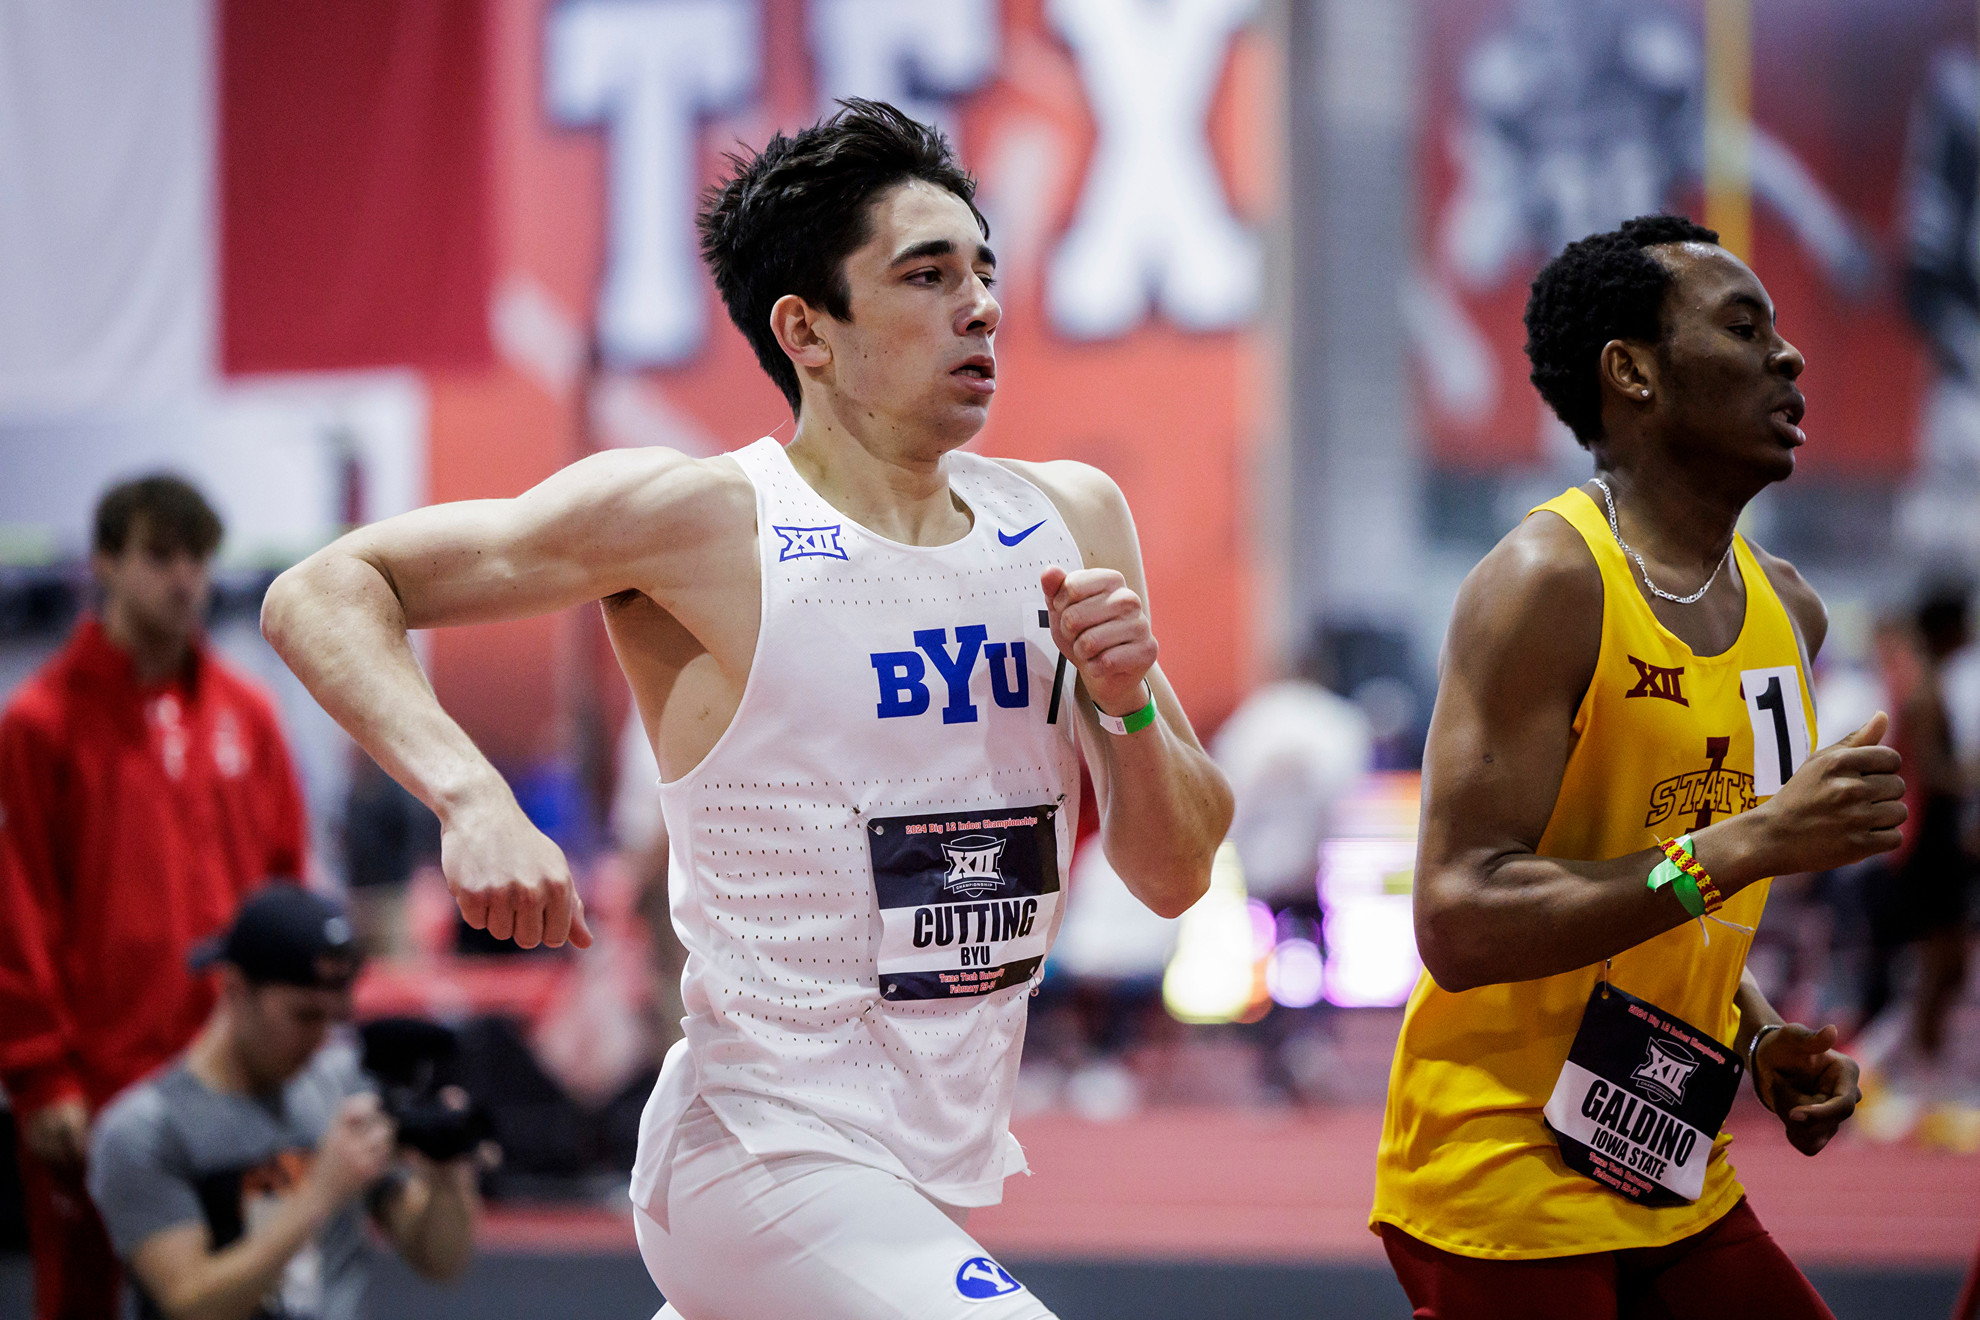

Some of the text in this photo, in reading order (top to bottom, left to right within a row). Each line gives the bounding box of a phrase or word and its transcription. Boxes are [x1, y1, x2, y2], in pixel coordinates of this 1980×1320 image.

[870, 624, 1029, 725] BYU
[1624, 654, 1690, 708] XII
[1755, 676, 1793, 786] 1
[905, 824, 927, 834] 2024
[928, 823, 943, 834] Big
[945, 822, 957, 832] 12
[958, 820, 982, 831] Indoor
[912, 898, 1038, 948] CUTTING
[939, 973, 960, 983] Texas
[960, 971, 978, 981] Tech
[960, 945, 990, 966] BYU
[1581, 1079, 1697, 1167] GALDINO
[1590, 1127, 1668, 1181] IOWA STATE
[961, 1260, 1015, 1293] Y
